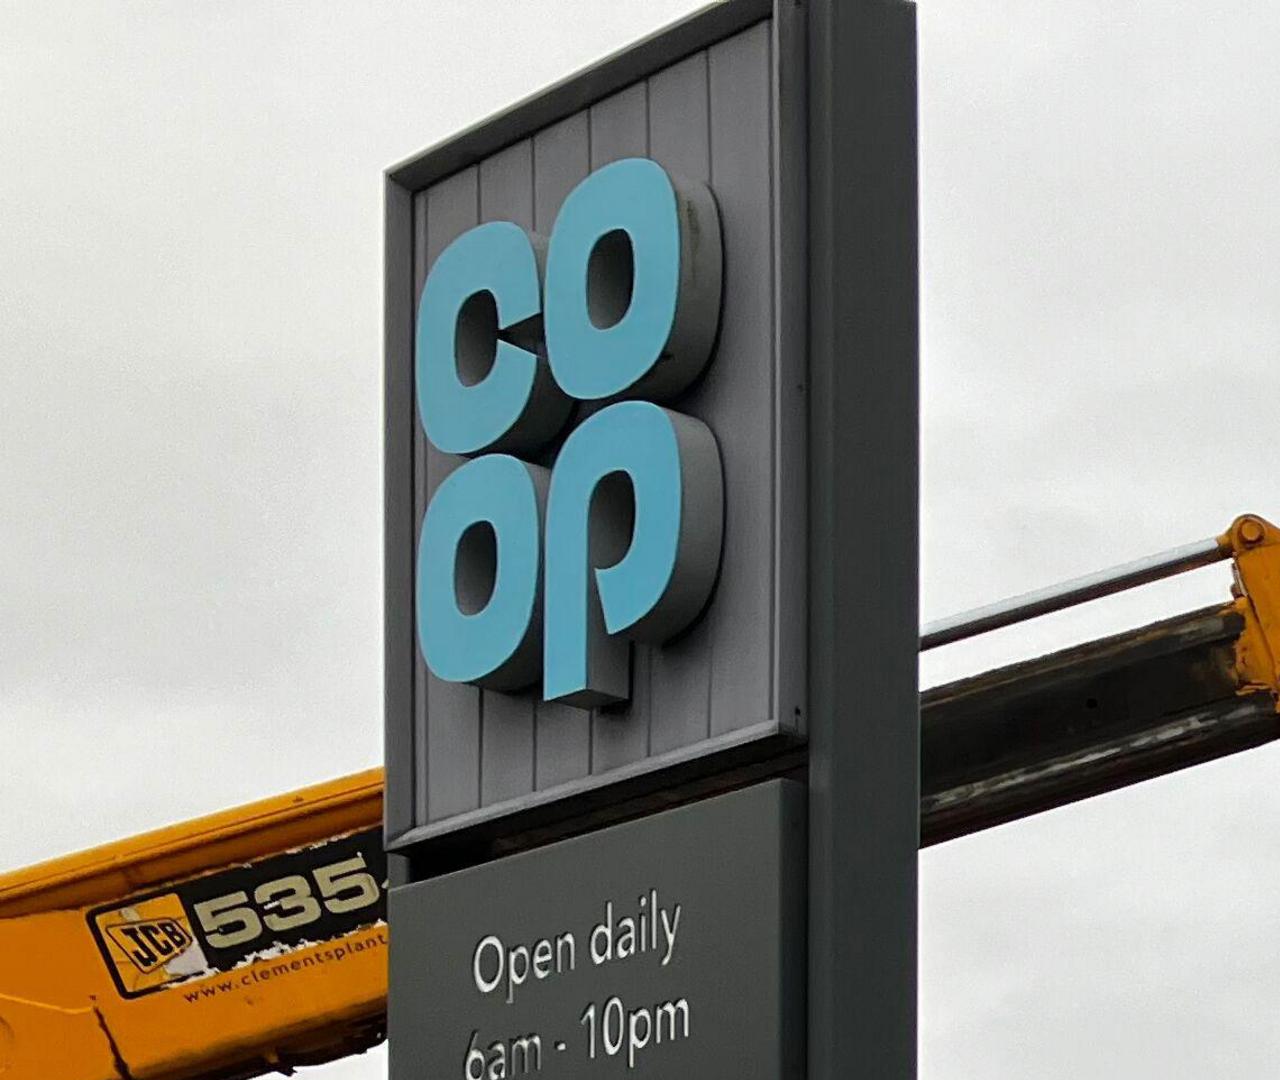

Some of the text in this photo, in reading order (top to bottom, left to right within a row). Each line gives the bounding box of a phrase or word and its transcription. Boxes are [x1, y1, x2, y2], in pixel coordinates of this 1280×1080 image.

[120, 921, 188, 967] JCB
[193, 857, 386, 949] 535
[473, 889, 682, 1004] Open daily
[579, 996, 690, 1069] 10pm
